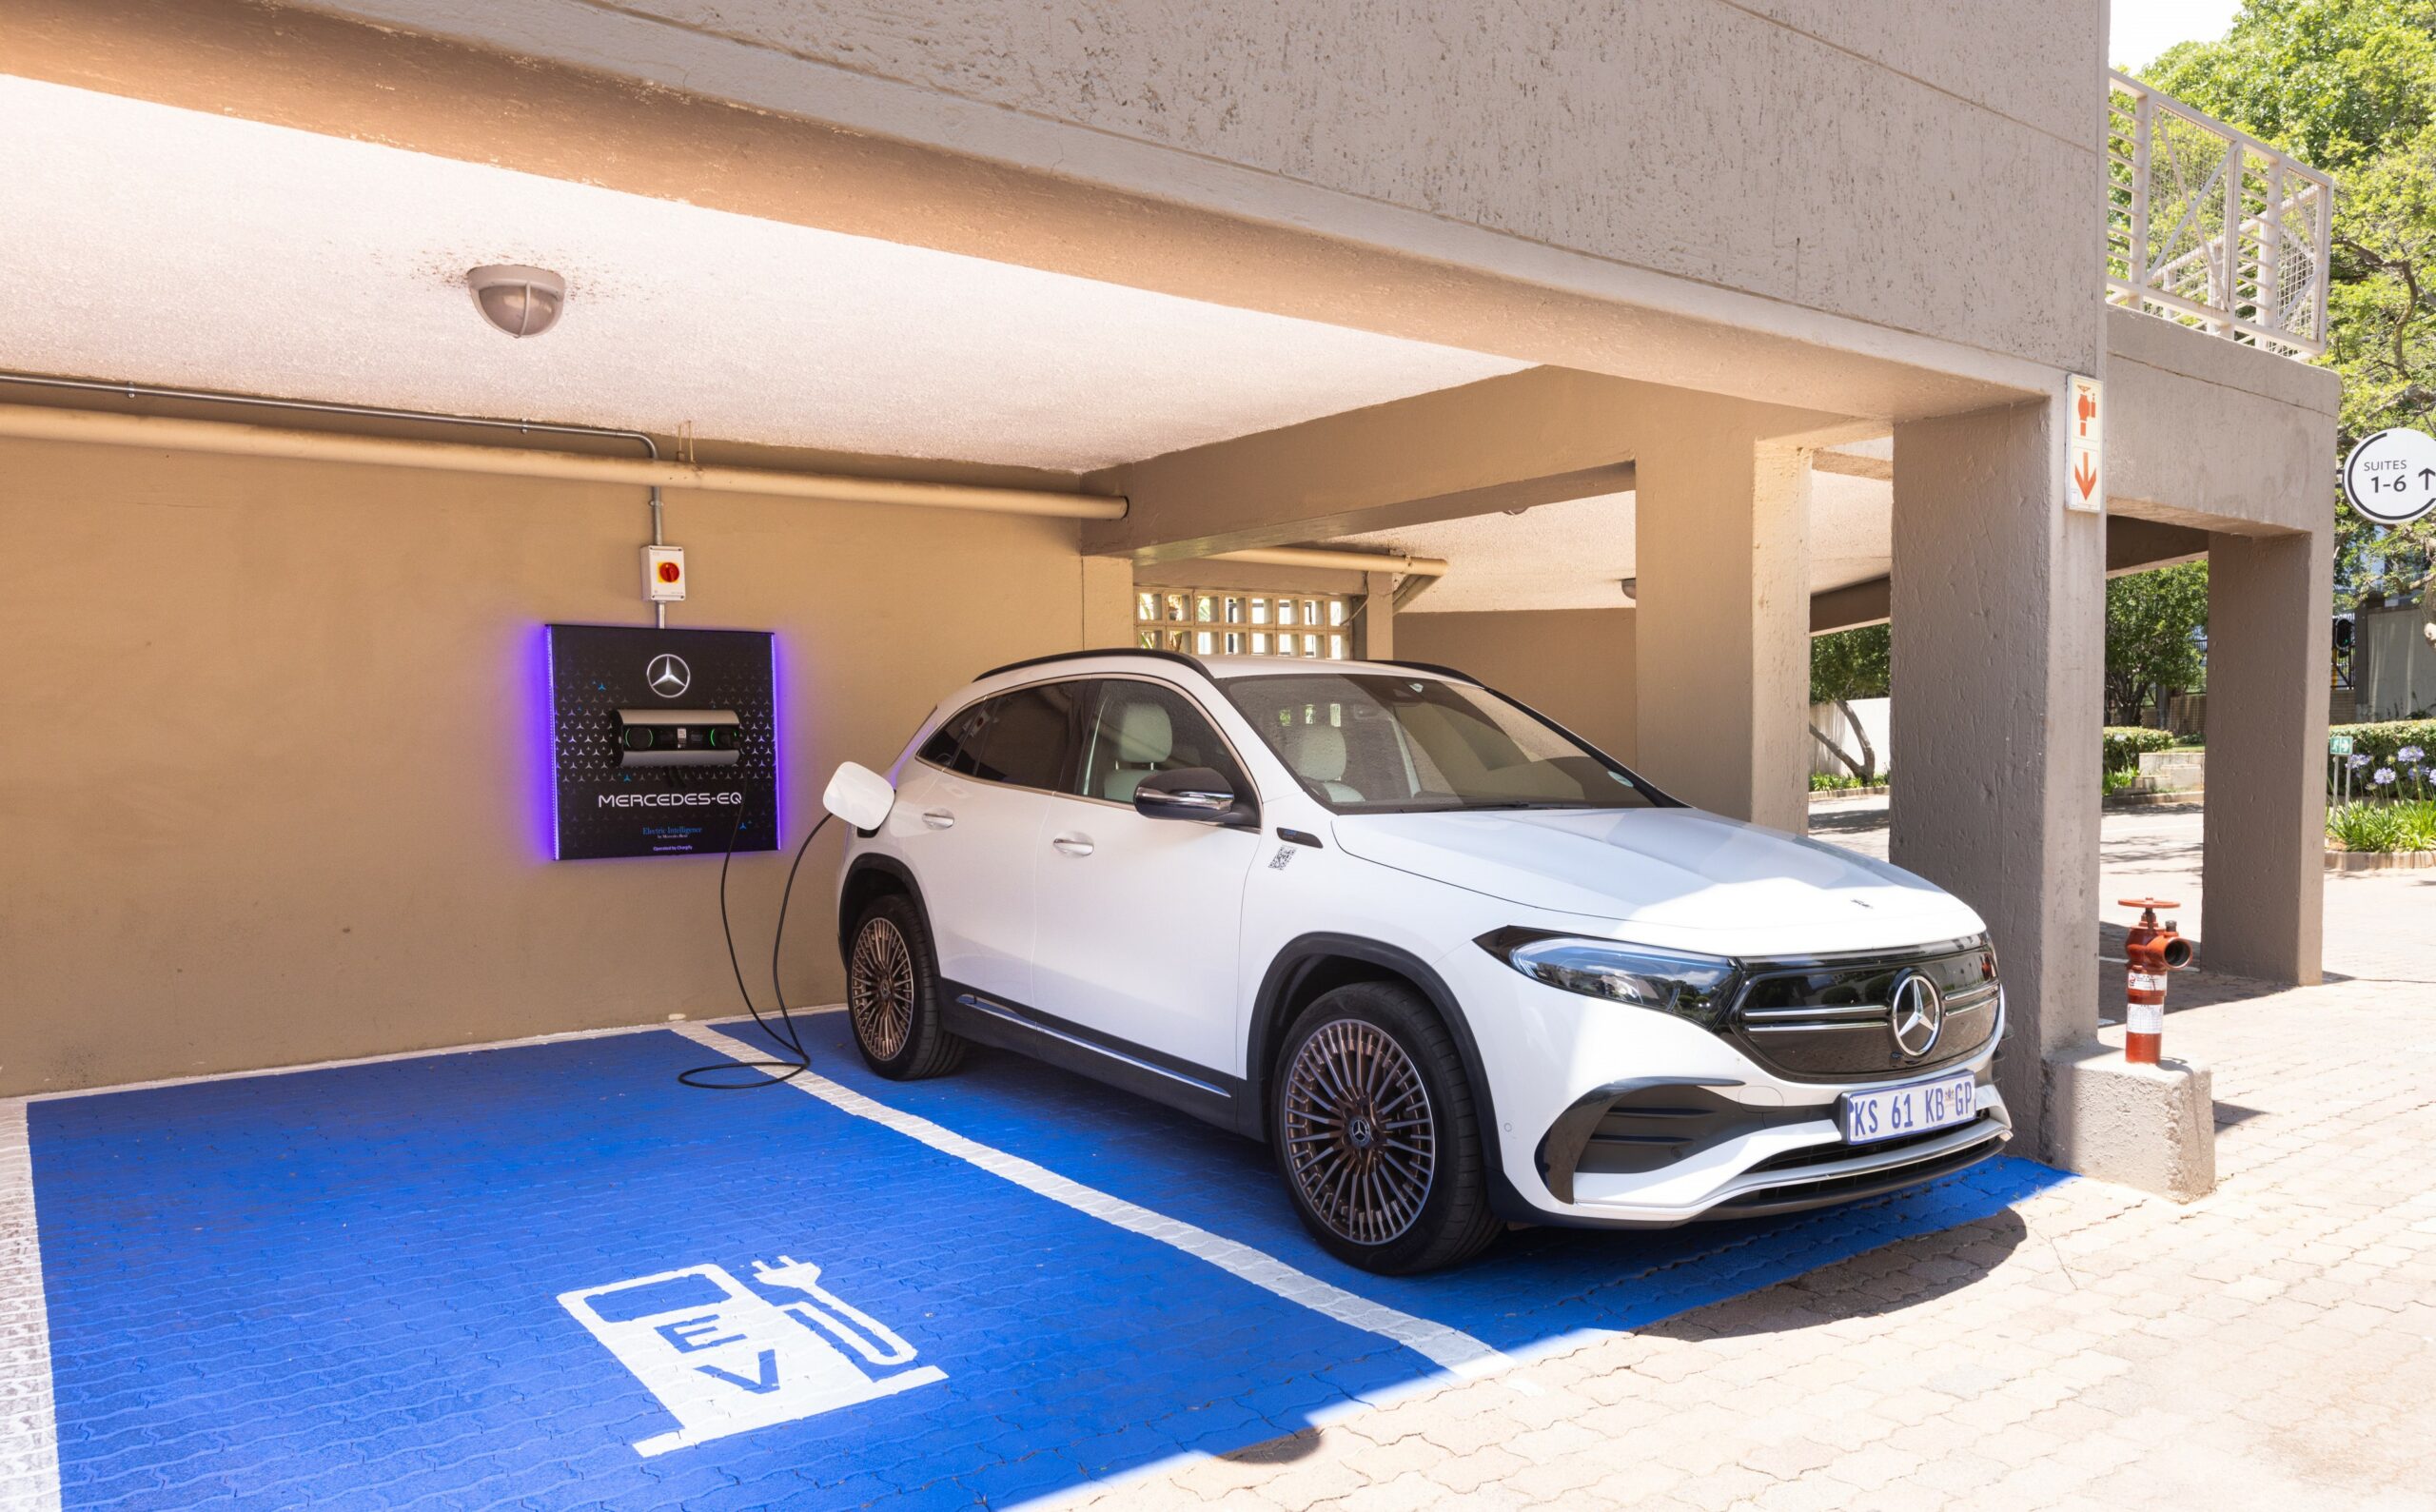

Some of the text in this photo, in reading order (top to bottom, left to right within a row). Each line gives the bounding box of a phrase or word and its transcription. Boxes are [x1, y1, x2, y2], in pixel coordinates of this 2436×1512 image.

[2364, 460, 2407, 472] SUITES
[2370, 475, 2407, 493] 1-6
[599, 792, 742, 808] MERCEDES-EQ
[1855, 1081, 1973, 1137] KS 61 KB GP
